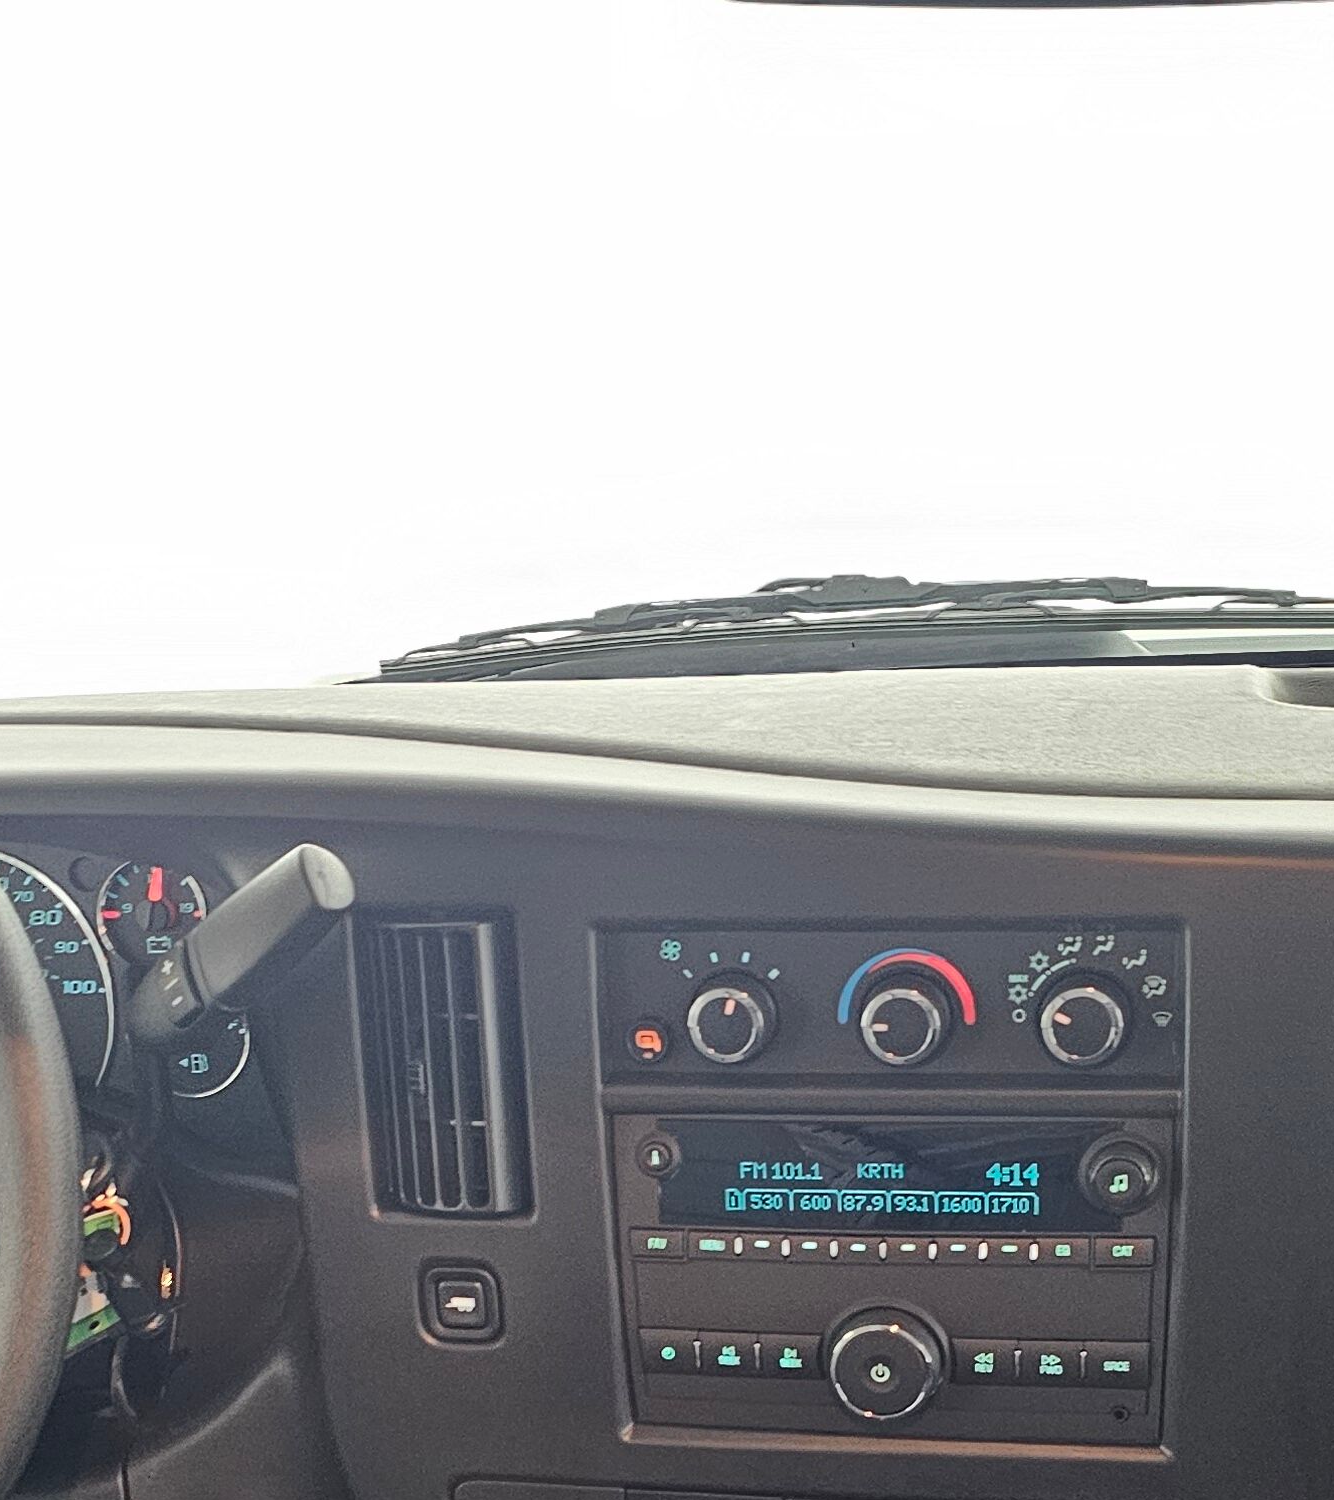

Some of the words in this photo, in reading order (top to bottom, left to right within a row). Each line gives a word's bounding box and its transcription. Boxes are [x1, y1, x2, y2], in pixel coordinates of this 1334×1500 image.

[12, 890, 35, 903] 70
[121, 902, 133, 914] 9
[29, 910, 63, 926] 80
[54, 941, 79, 954] 90
[62, 980, 98, 994] 100
[739, 1161, 768, 1180] FM
[770, 1162, 824, 1181] 101.1
[856, 1162, 905, 1180] KRTH
[984, 1162, 1041, 1187] 4:14
[750, 1195, 783, 1211] 530
[800, 1195, 832, 1212] 600
[843, 1195, 885, 1212] 87.9
[894, 1197, 930, 1214] 93.1
[941, 1197, 983, 1214] 1600
[991, 1198, 1030, 1214] 1710
